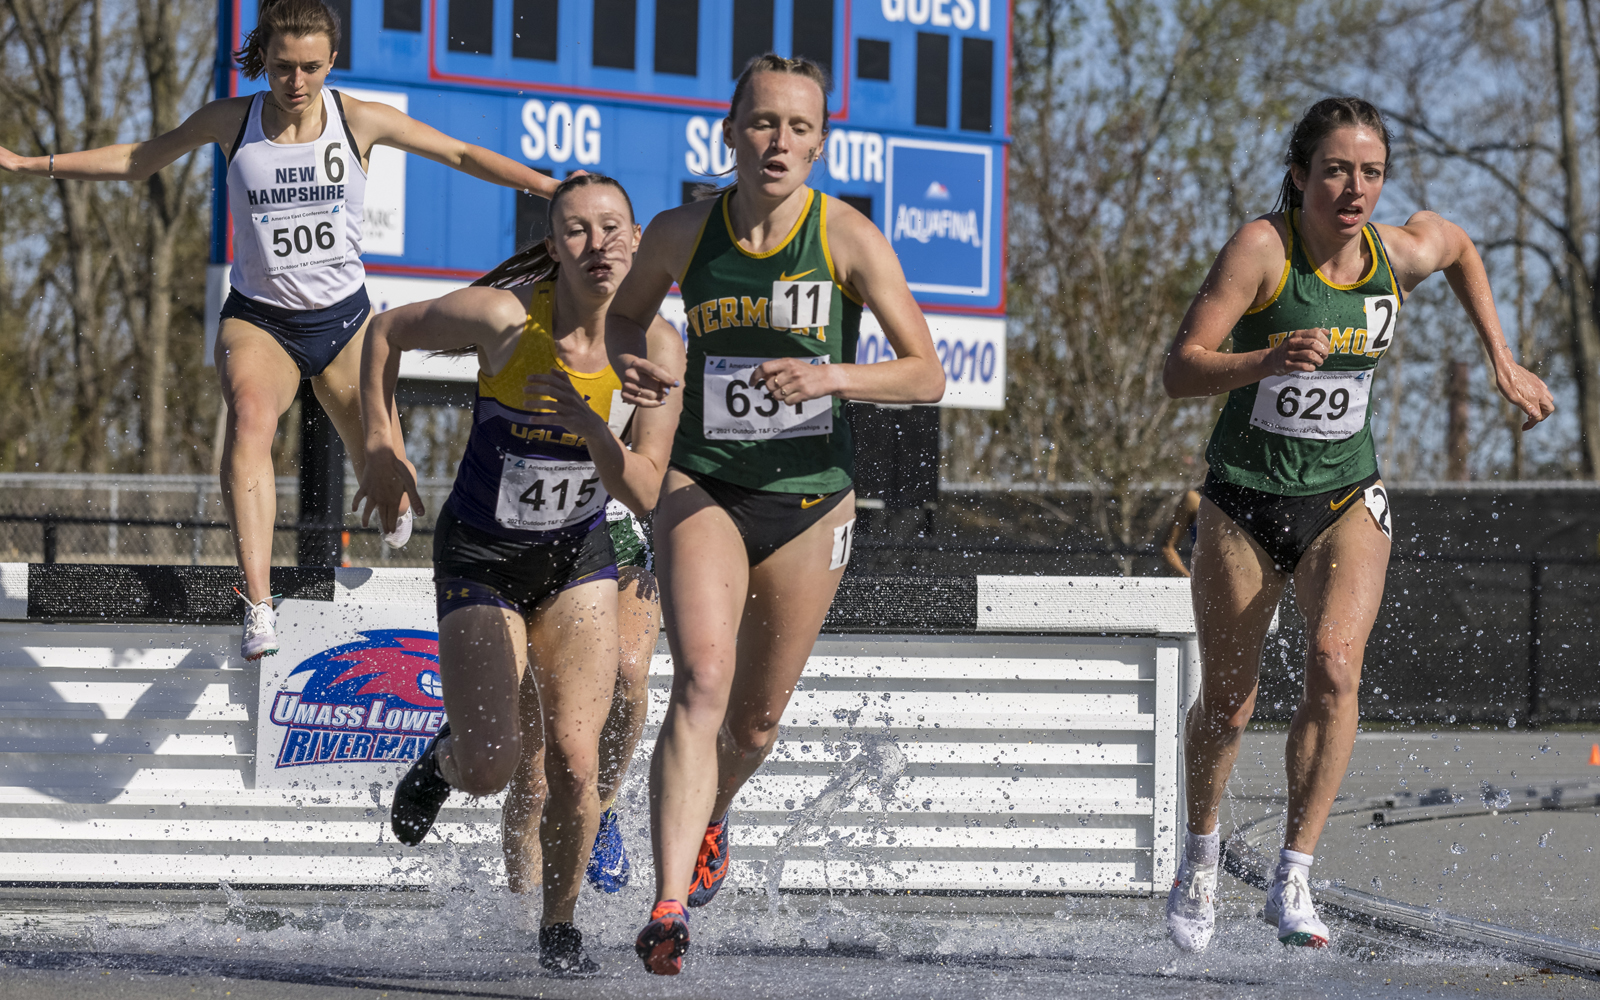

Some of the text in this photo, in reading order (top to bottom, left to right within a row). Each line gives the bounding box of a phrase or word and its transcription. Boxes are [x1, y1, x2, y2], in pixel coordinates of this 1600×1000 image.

[521, 99, 600, 165] SOG
[275, 166, 316, 184] NEW
[324, 142, 345, 183] 6
[828, 129, 884, 183] QTR
[247, 185, 345, 205] HAMPSHIRE
[272, 221, 335, 257] 506
[894, 204, 981, 248] AQUAFINA
[688, 296, 826, 342] VERM
[784, 284, 820, 325] 11
[1372, 299, 1393, 349] 2
[1276, 386, 1349, 420] 629
[519, 477, 600, 511] 415
[273, 694, 366, 728] UMASS
[277, 728, 373, 766] RIVER
